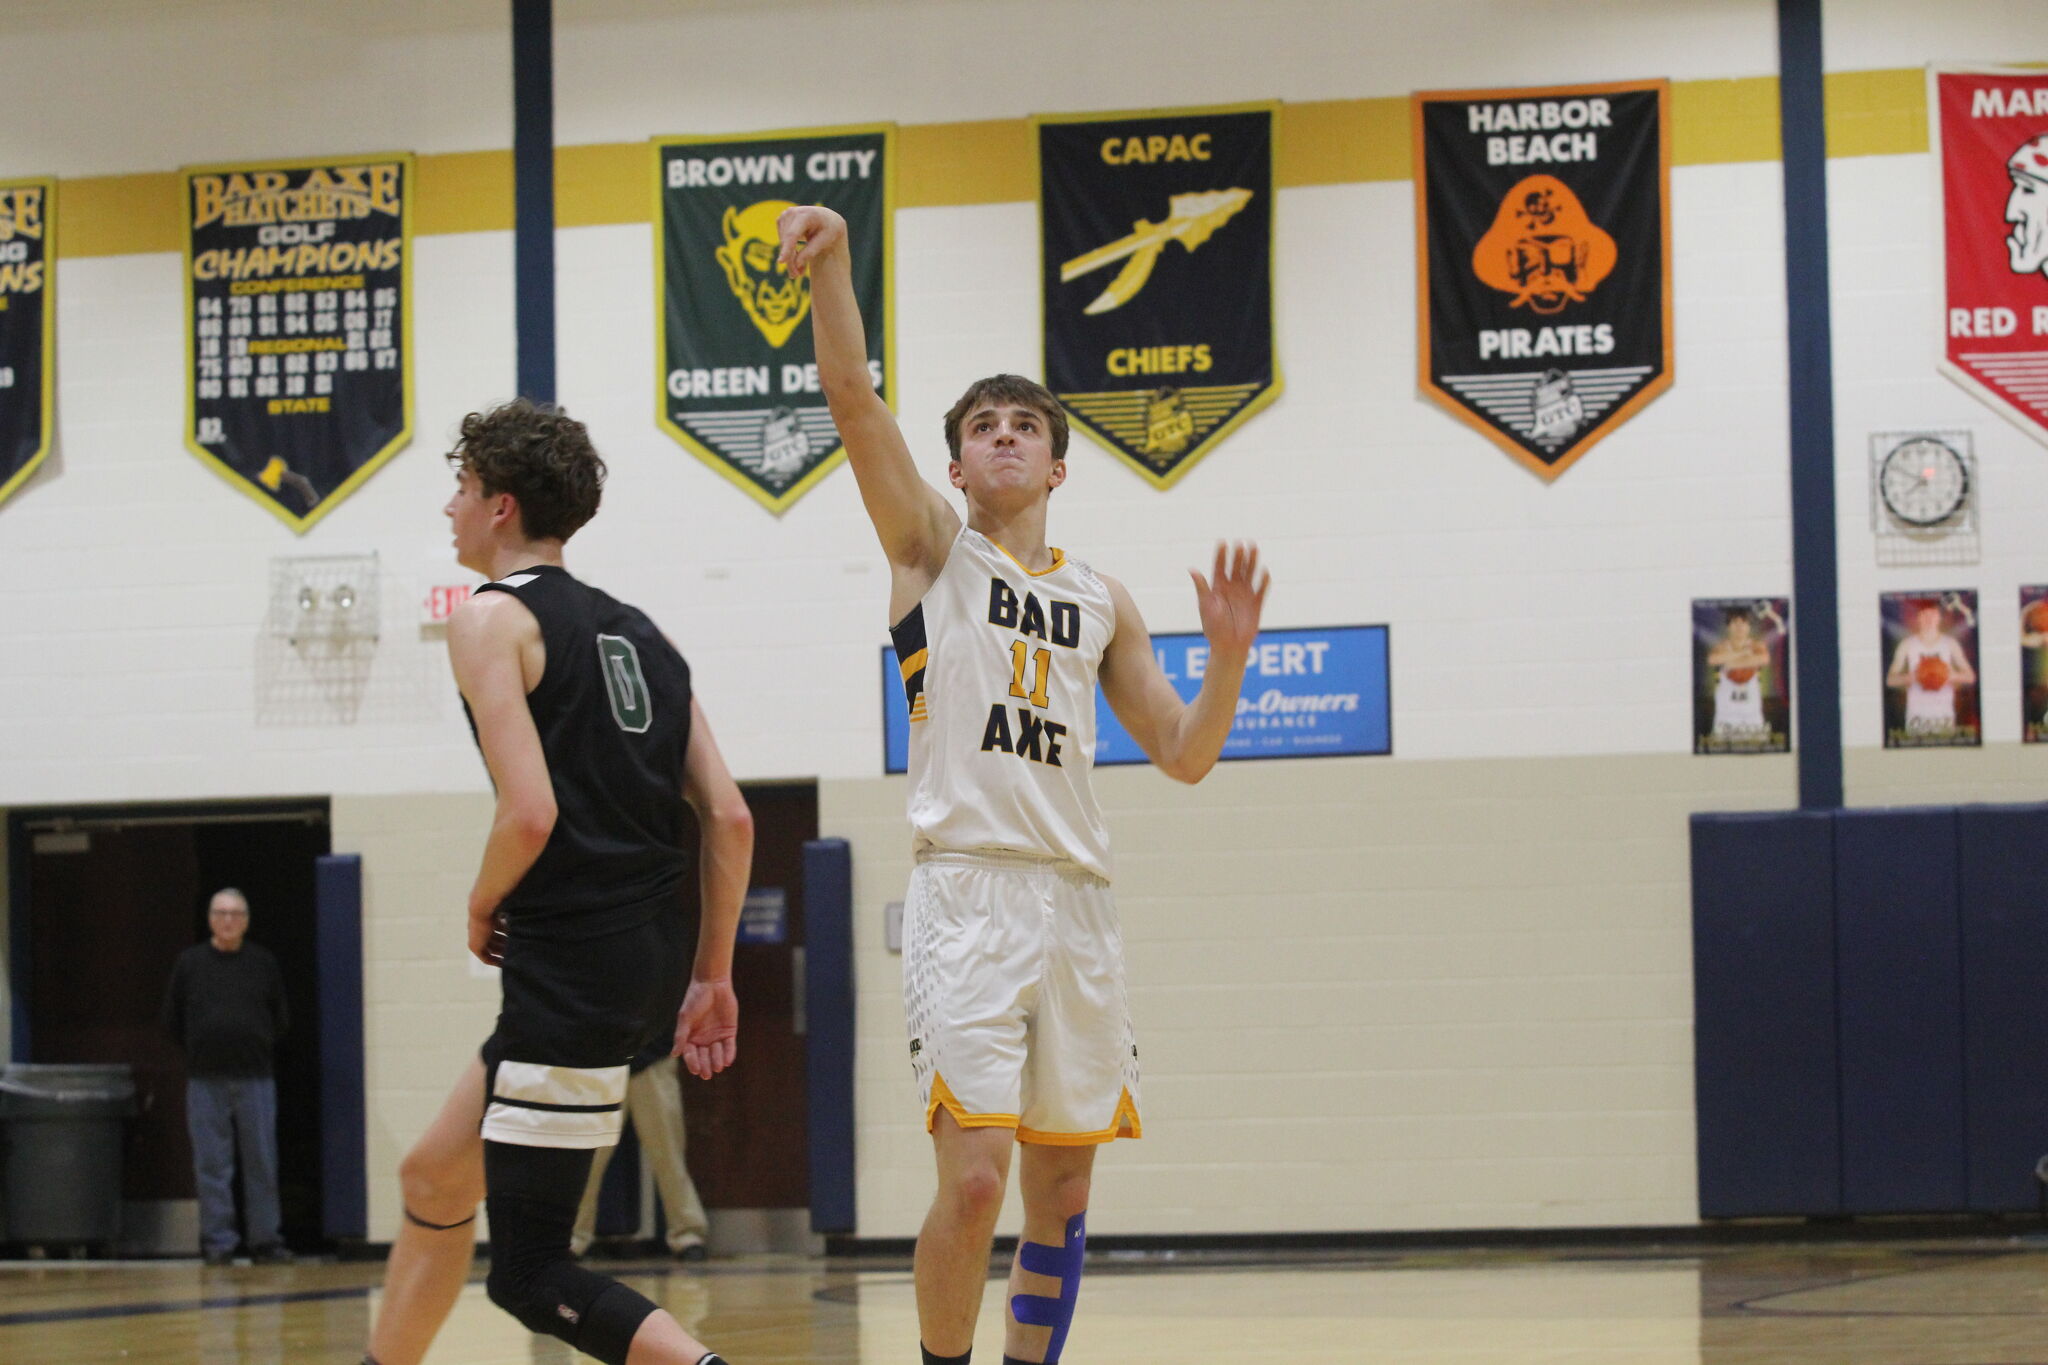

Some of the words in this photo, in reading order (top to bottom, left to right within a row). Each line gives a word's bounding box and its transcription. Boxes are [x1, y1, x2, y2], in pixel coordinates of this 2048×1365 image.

[1468, 99, 1612, 133] HARBOR
[1971, 88, 2048, 118] MAR
[1101, 134, 1212, 165] CAPAC
[1487, 133, 1598, 166] BEACH
[667, 154, 795, 188] BROWN
[806, 150, 876, 181] CITY
[193, 171, 289, 229] BAD
[301, 164, 400, 217] AXE
[223, 188, 371, 227] HATCHETS
[258, 222, 336, 246] GOLF
[193, 238, 401, 281] CHAMPIONS
[230, 274, 365, 295] CONFERENCE
[1949, 307, 2018, 337] RED
[249, 337, 347, 355] REGIONAL
[1479, 324, 1615, 359] PIRATES
[1106, 345, 1213, 376] CHIEFS
[668, 365, 769, 398] GREEN
[781, 360, 883, 394] DES
[267, 397, 331, 415] STATE
[988, 577, 1081, 649] BAD
[1008, 640, 1052, 710] 11
[1186, 642, 1330, 680] EPERT
[980, 704, 1067, 768] AXE
